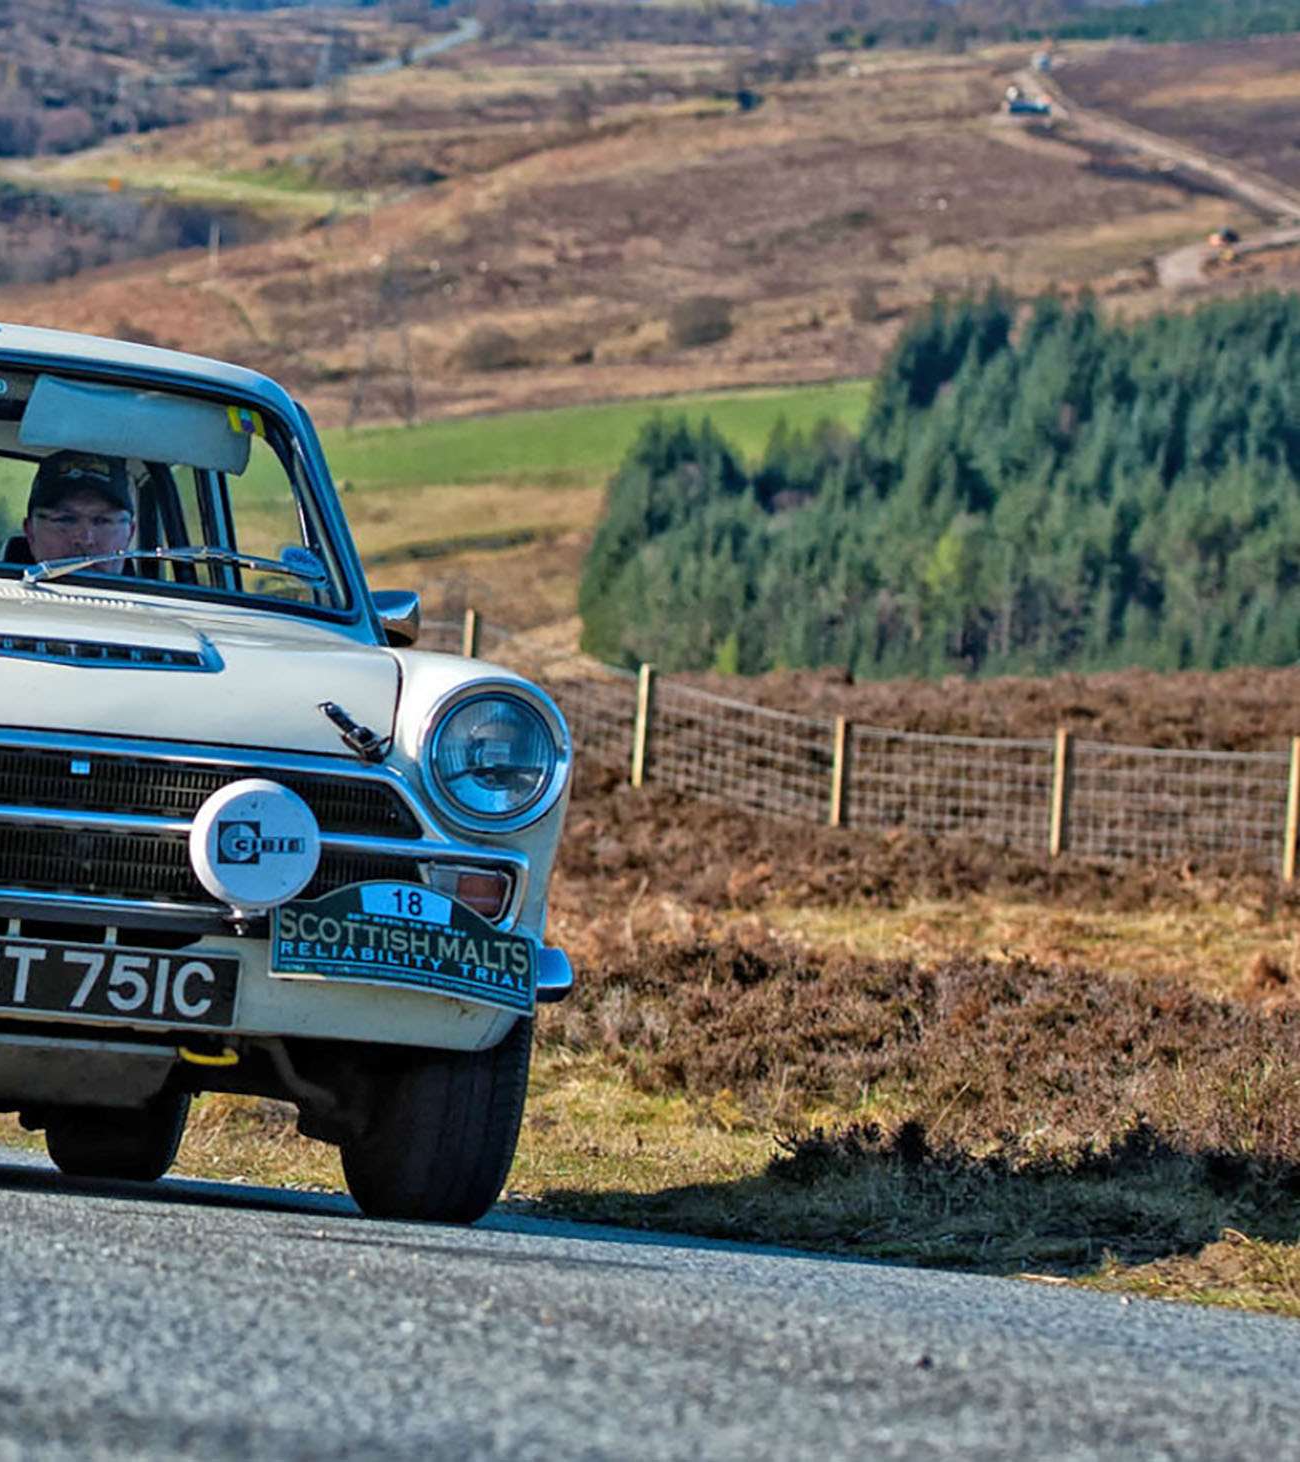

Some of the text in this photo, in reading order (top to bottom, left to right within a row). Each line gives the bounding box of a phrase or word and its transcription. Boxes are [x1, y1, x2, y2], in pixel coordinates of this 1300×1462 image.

[392, 888, 423, 916] 18
[280, 908, 431, 957] SCOTTISH
[438, 935, 529, 975] MALTS
[280, 941, 443, 971] RELIABILITY
[460, 963, 529, 990] TRIAL
[63, 952, 216, 1018] 751C
